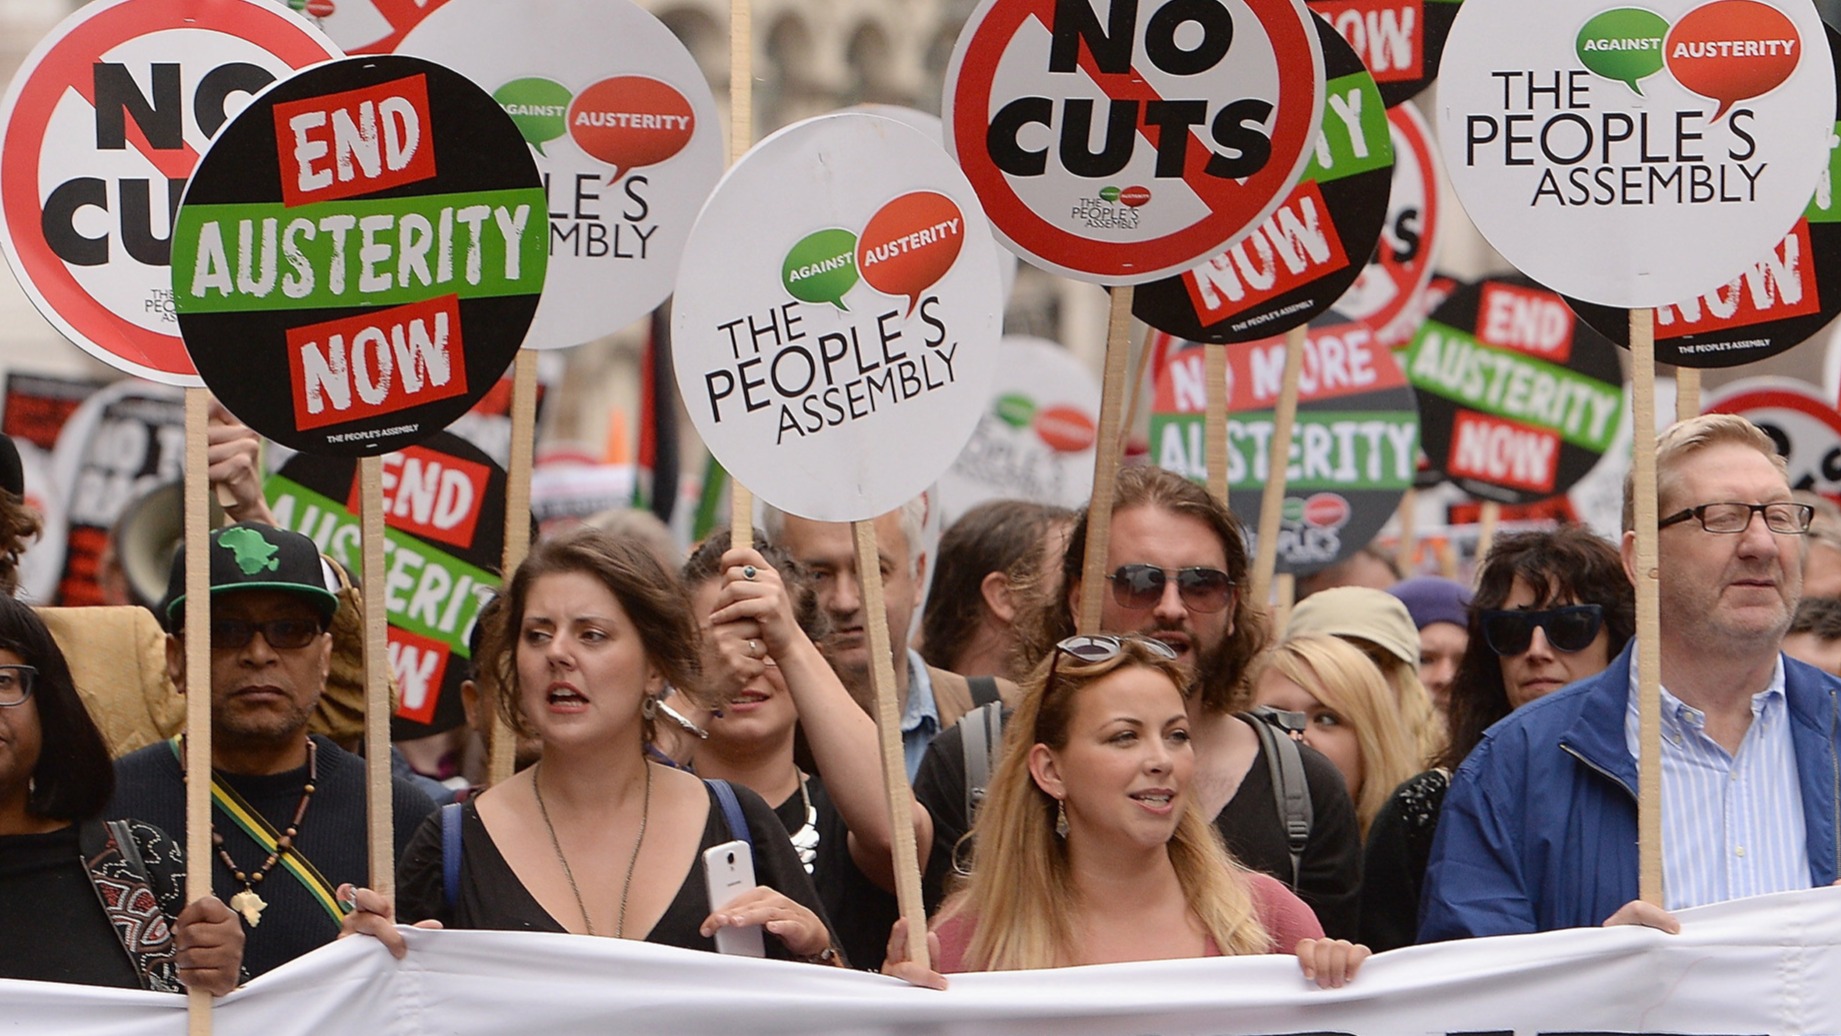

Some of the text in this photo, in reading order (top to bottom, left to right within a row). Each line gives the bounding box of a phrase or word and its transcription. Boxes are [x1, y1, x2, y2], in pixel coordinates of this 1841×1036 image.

[1048, 0, 1234, 76] NO
[1319, 6, 1415, 73] OW
[1583, 37, 1661, 51] AGAINST
[1672, 39, 1796, 59] AUSTERITY
[500, 103, 565, 117] GAINST
[1491, 70, 1591, 110] THE
[289, 96, 421, 192] END
[575, 111, 691, 131] AUSTERITY
[986, 96, 1274, 179] CUTS
[1080, 198, 1102, 207] THE
[1530, 162, 1768, 207] ASSEMBLY
[41, 177, 189, 266] CU
[864, 217, 960, 267] AUSTERITY
[1084, 219, 1139, 230] ASSEMBLY
[191, 204, 531, 299] AUSTERITY
[789, 252, 853, 282] AGAINST
[717, 301, 807, 360] THE
[1483, 289, 1571, 350] END
[1678, 345, 1695, 354] THE
[1731, 338, 1771, 349] ASSEMBLY
[300, 311, 451, 415] NOW
[1250, 329, 1377, 400] MORE
[1411, 330, 1618, 443] AUSTERITY
[777, 342, 958, 445] ASSEMBLY
[326, 423, 419, 443] THE PEOPLE'S ASSEMBLY
[1454, 419, 1555, 485] NOW
